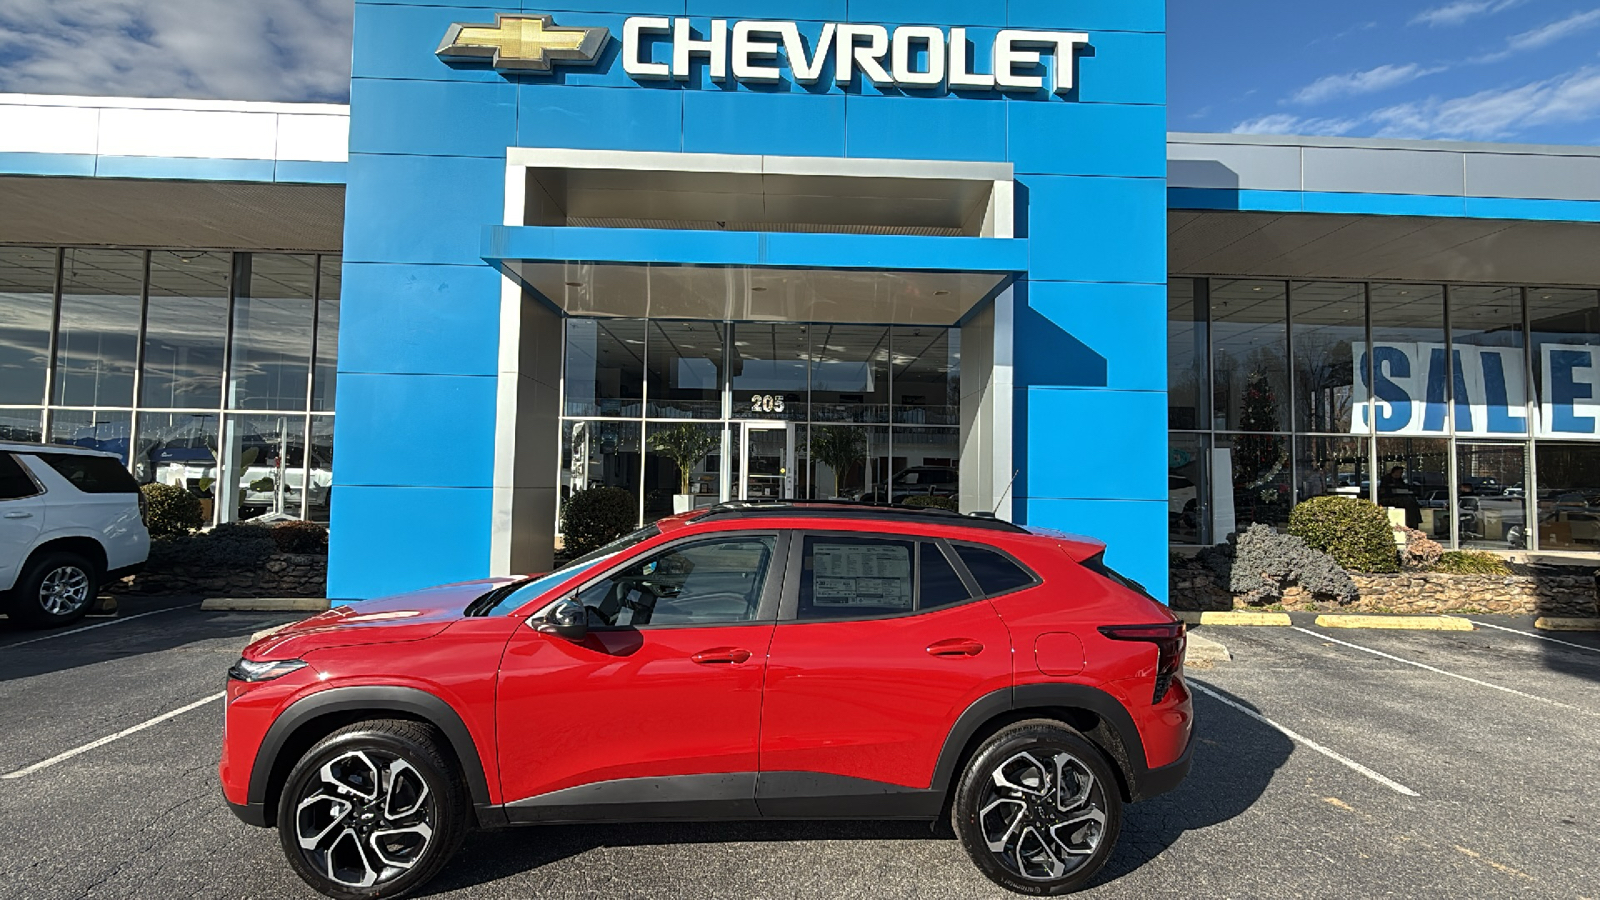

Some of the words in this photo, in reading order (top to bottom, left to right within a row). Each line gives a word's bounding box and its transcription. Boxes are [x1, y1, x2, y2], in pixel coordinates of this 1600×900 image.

[622, 16, 1088, 94] CHEVROLET
[751, 394, 785, 412] 205
[1360, 346, 1595, 433] SALE
